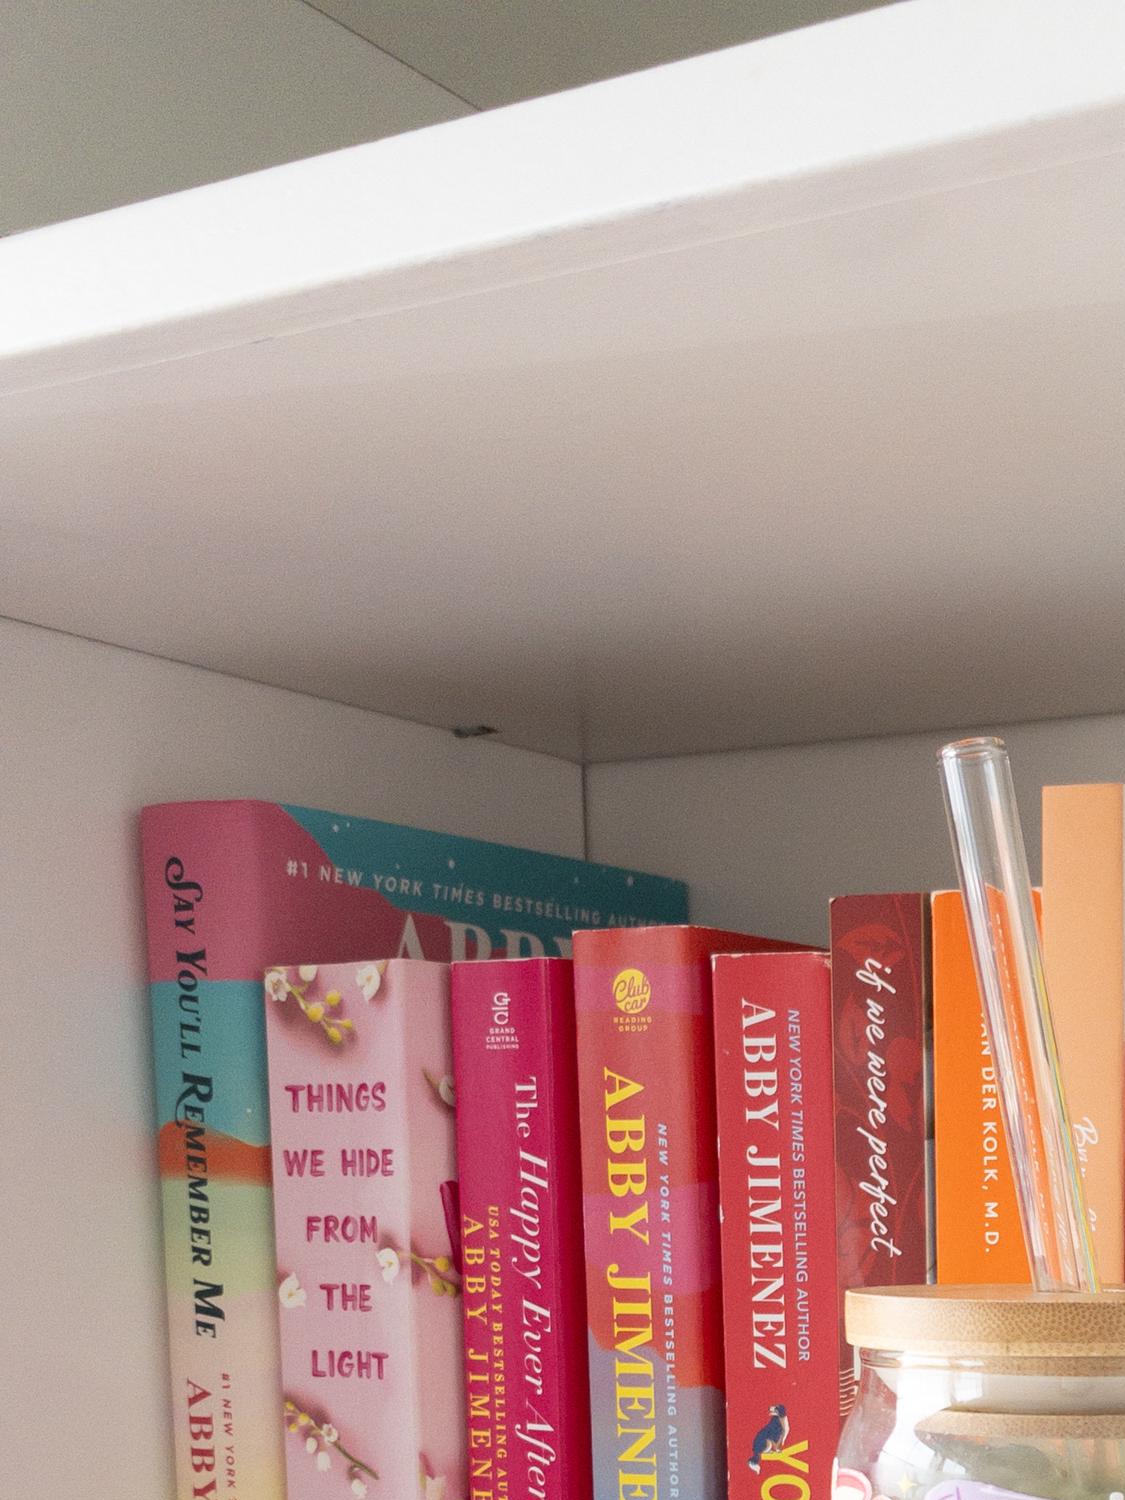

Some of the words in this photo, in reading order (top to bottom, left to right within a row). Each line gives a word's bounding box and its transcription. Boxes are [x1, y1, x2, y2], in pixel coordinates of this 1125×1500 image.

[286, 859, 309, 879] #1
[319, 865, 363, 887] NEW
[373, 872, 423, 897] YORK
[433, 883, 484, 907] TIMES
[493, 893, 600, 925] BESTSELLING
[856, 958, 897, 994] if
[486, 1035, 520, 1043] CENTRAL
[489, 1027, 515, 1035] GRAND
[787, 1008, 800, 1051] NEW
[866, 998, 886, 1046] we
[741, 997, 780, 1131] ABBY
[789, 1057, 804, 1104] YORK
[867, 1051, 888, 1129] were
[285, 1081, 387, 1114] THINGS
[515, 1073, 538, 1139] The
[981, 1066, 997, 1132] DER
[283, 1148, 326, 1178] WE
[341, 1148, 394, 1178] HIDE
[604, 1066, 650, 1246] ABBY
[657, 1122, 670, 1166] NEW
[791, 1110, 805, 1162] TIMES
[980, 1121, 998, 1190] KOLK,
[174, 1071, 214, 1267] REMEMBER
[659, 1174, 672, 1224] YORK
[856, 1126, 902, 1258] perfect
[306, 1215, 378, 1244] FROM
[488, 1205, 500, 1241] USA
[509, 1146, 549, 1289] Happy
[792, 1168, 808, 1283] BESTSELLING
[983, 1202, 1000, 1253] M.D.
[463, 1215, 488, 1325] ABBY
[490, 1248, 503, 1314] TODAY
[661, 1232, 675, 1287] TIMES
[746, 1145, 787, 1369] JIMENEZ
[193, 1279, 226, 1339] ME
[319, 1283, 373, 1313] THE
[796, 1287, 810, 1361] AUTHOR
[311, 1349, 389, 1381] LIGHT
[522, 1296, 552, 1396] Ever
[664, 1294, 679, 1417] BESTSELLING
[222, 1398, 233, 1438] NEW
[492, 1322, 508, 1460] BESTSELLING
[225, 1445, 237, 1488] YORK
[667, 1424, 680, 1499] AUTHOR
